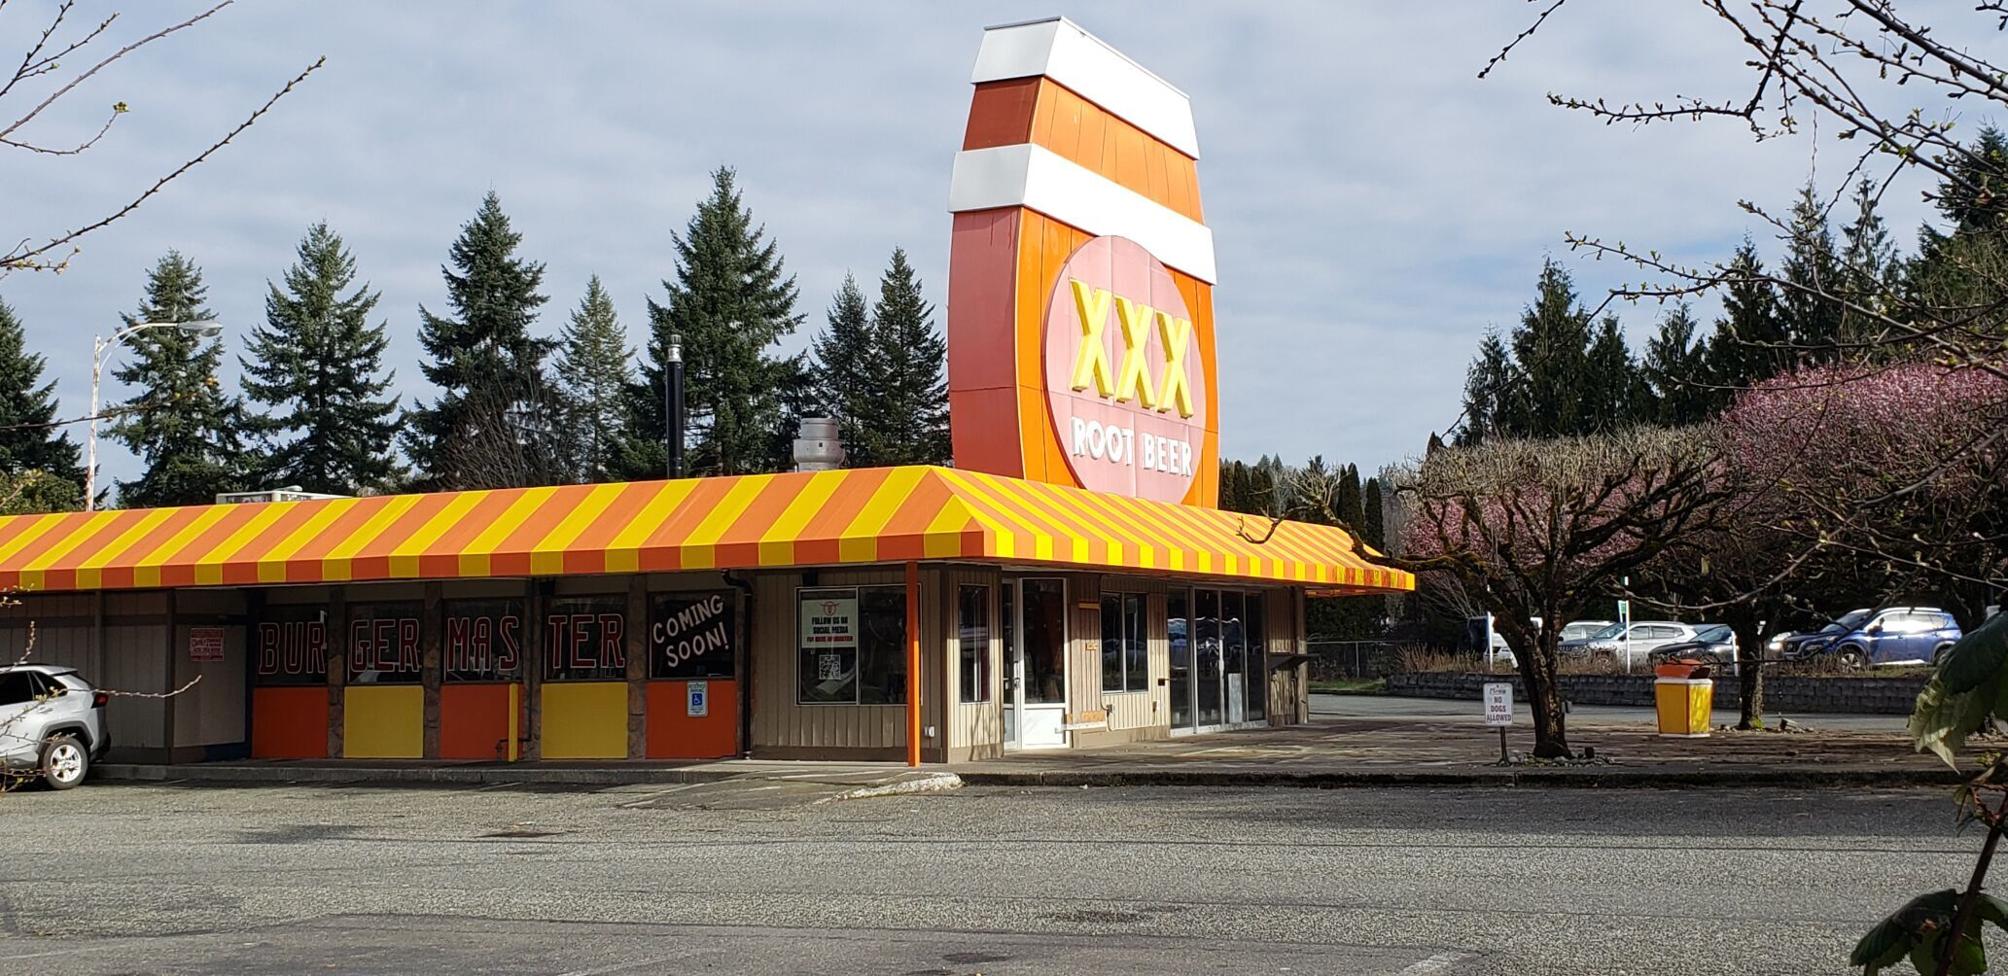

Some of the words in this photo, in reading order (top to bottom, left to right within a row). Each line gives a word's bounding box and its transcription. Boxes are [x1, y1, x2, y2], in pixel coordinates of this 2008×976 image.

[1068, 277, 1194, 419] XXX
[1070, 416, 1134, 466] ROOT
[1141, 432, 1193, 477] BEER
[653, 595, 724, 644] COMING
[811, 617, 831, 625] FOLLOW
[832, 626, 849, 634] MEDIA
[666, 622, 729, 667] SOON!
